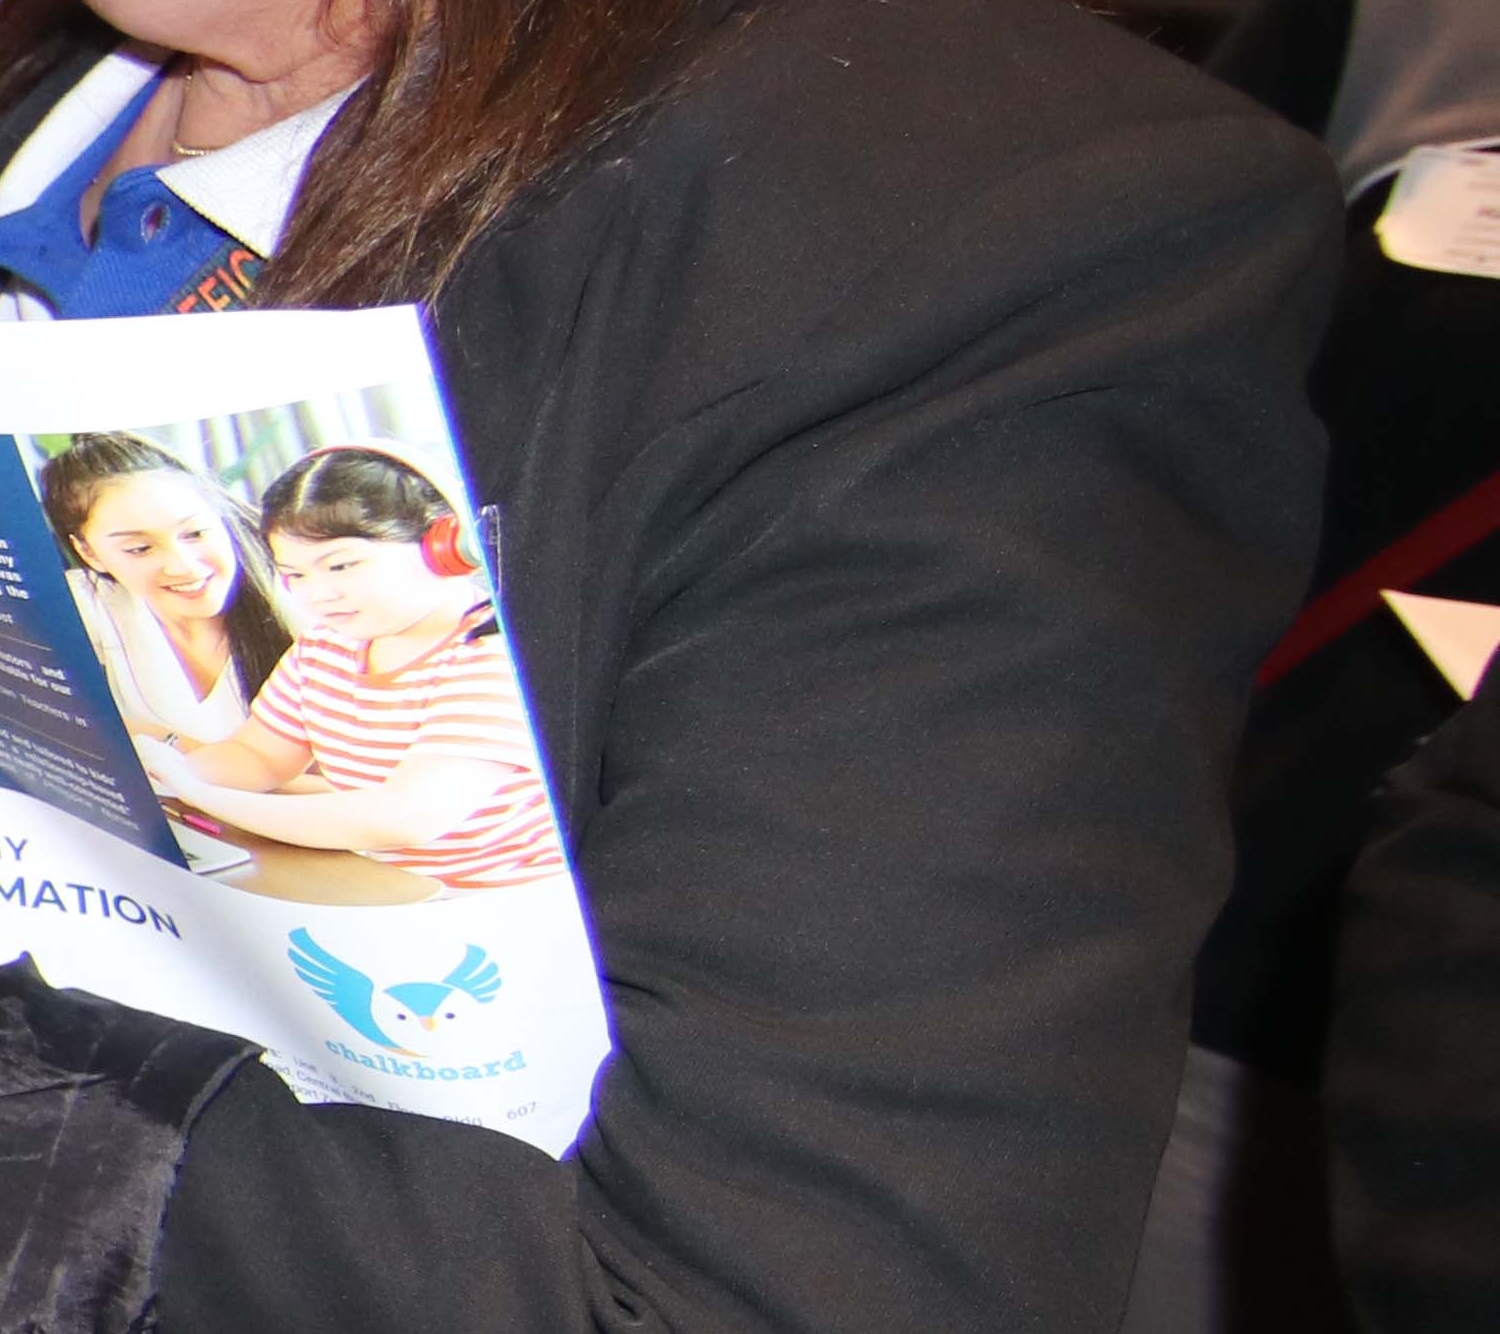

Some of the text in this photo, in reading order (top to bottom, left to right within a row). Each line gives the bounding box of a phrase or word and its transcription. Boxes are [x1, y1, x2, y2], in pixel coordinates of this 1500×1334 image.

[5, 585, 30, 600] the
[325, 1038, 527, 1081] chalkboard
[506, 1101, 537, 1121] 607
